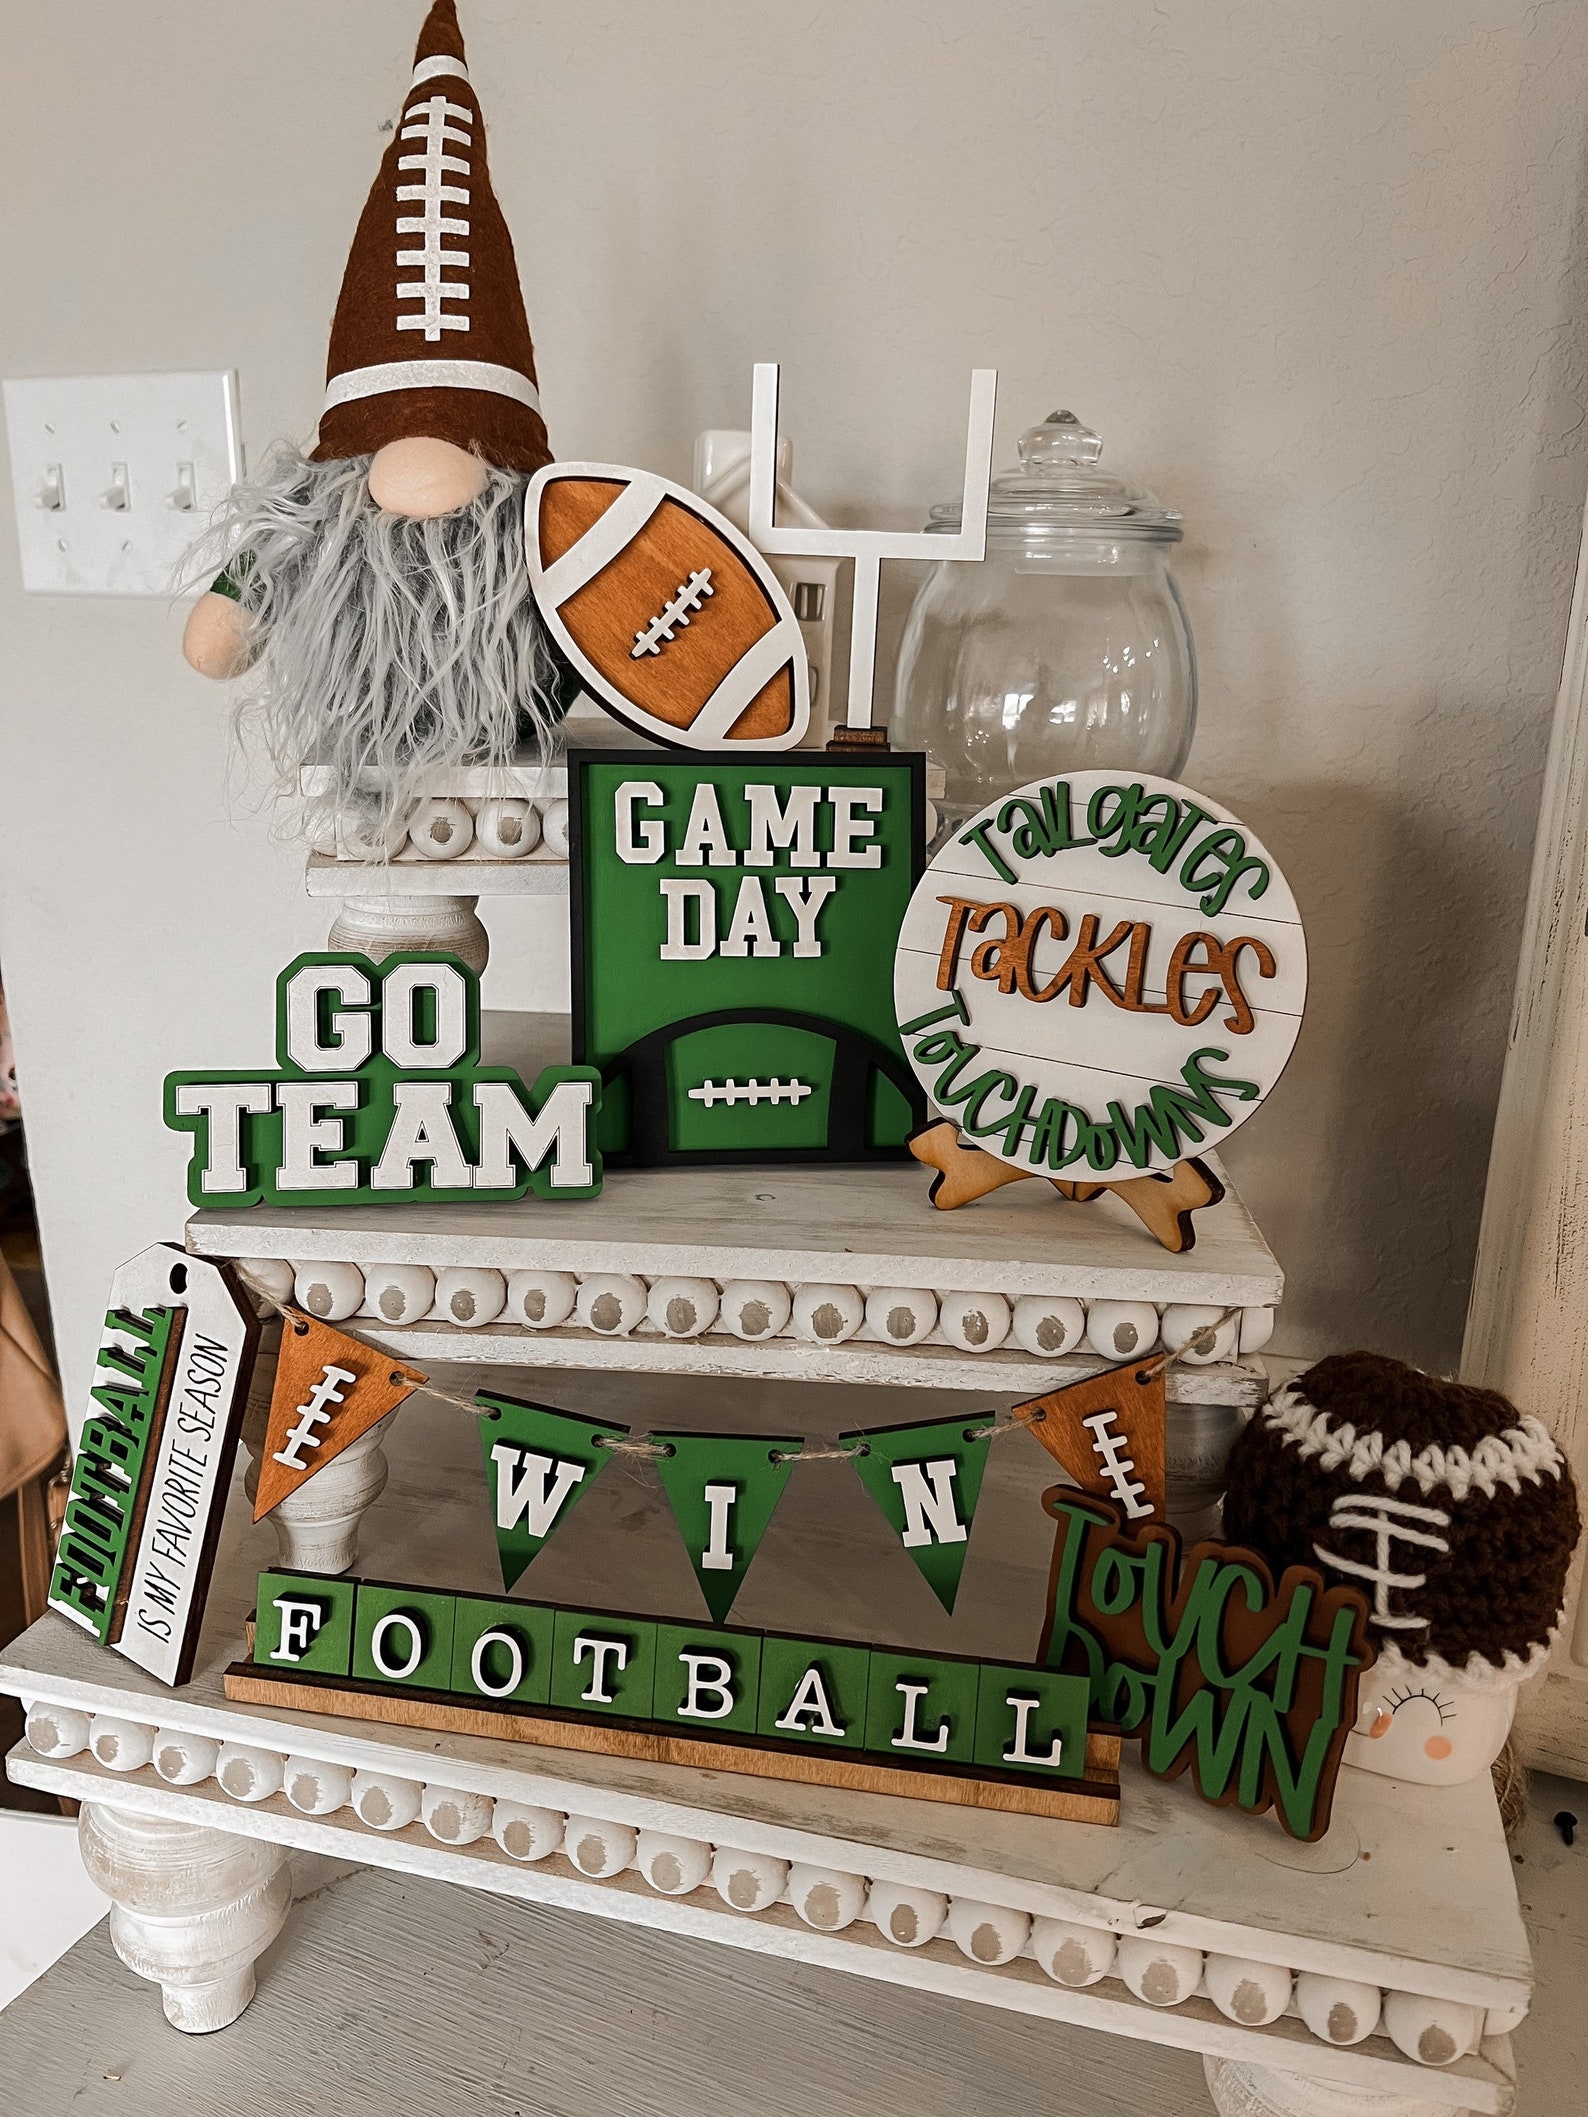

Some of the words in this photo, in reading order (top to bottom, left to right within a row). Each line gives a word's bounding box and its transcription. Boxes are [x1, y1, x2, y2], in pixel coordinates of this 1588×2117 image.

[614, 781, 883, 870] GAME
[659, 875, 837, 961] DAY
[286, 963, 467, 1073] GO
[175, 1081, 593, 1194] TEAM
[178, 1332, 229, 1443] SEASON
[50, 1305, 173, 1643] FOOTBALL
[152, 1438, 208, 1568] FAVORITE
[489, 1444, 968, 1570] WIN
[136, 1609, 172, 1643] IS
[143, 1557, 181, 1610] MY
[270, 1599, 1063, 1768] FOOTBALL
